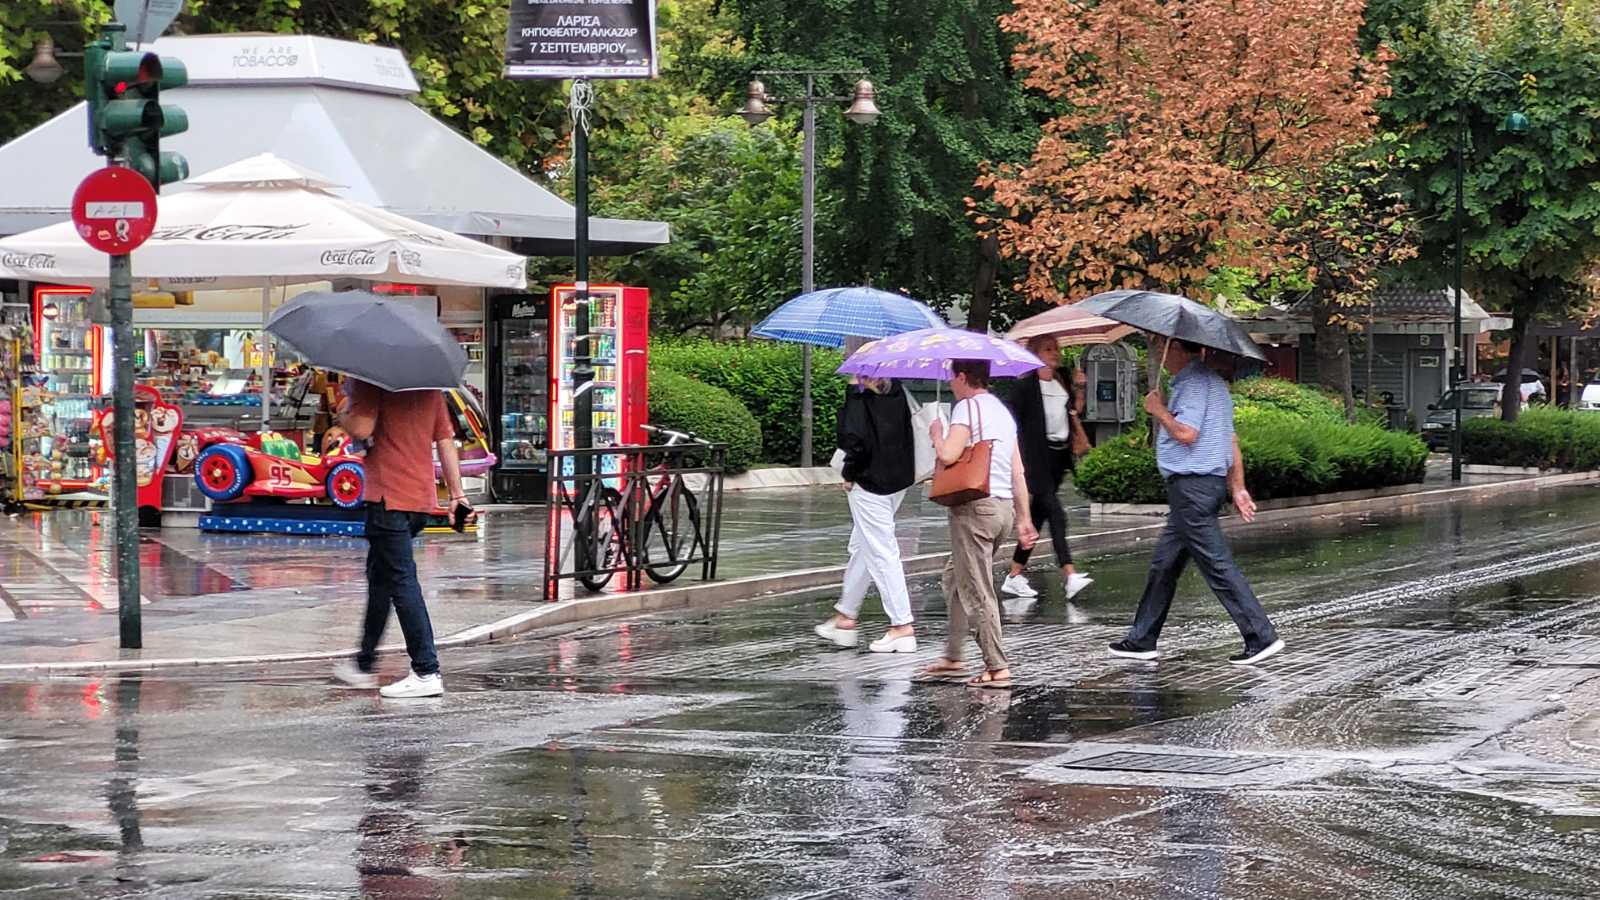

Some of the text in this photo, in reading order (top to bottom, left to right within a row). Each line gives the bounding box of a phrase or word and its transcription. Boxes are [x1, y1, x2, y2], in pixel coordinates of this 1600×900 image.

[556, 15, 601, 27] ΛΑΡΙΣΑ
[521, 28, 638, 38] ΚΗΠΟΘΕΑΤΡΟ ΑΛΚΑΖΑΡ
[529, 42, 537, 54] 7
[540, 42, 627, 54] ΣΕΠΤΕΜΒΡΙΟΥ
[232, 55, 299, 67] TOBACCO
[270, 465, 293, 487] 95
